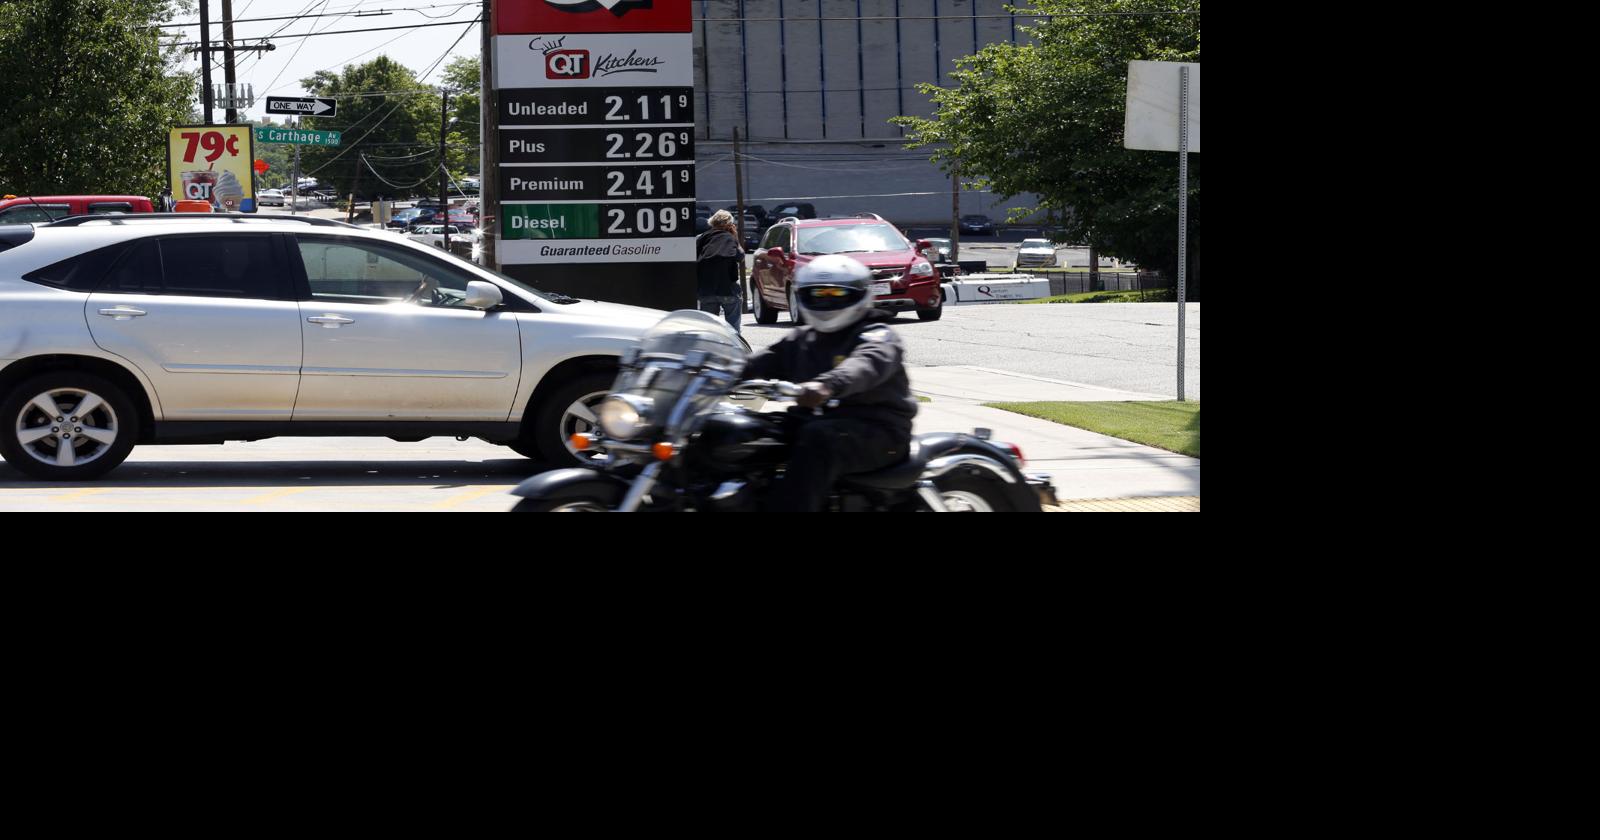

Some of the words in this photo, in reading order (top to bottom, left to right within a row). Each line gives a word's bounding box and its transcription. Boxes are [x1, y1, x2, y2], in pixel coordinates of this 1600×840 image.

[549, 54, 584, 76] QT
[592, 49, 665, 77] Kitchens
[273, 101, 291, 110] ONE
[508, 102, 588, 116] Unleaded
[269, 130, 320, 144] Carthage
[509, 140, 545, 153] Plus
[186, 183, 213, 199] QT
[510, 177, 584, 191] Premium
[511, 215, 565, 229] Diesel
[540, 245, 610, 257] Guaranteed
[612, 244, 661, 255] Gasoline
